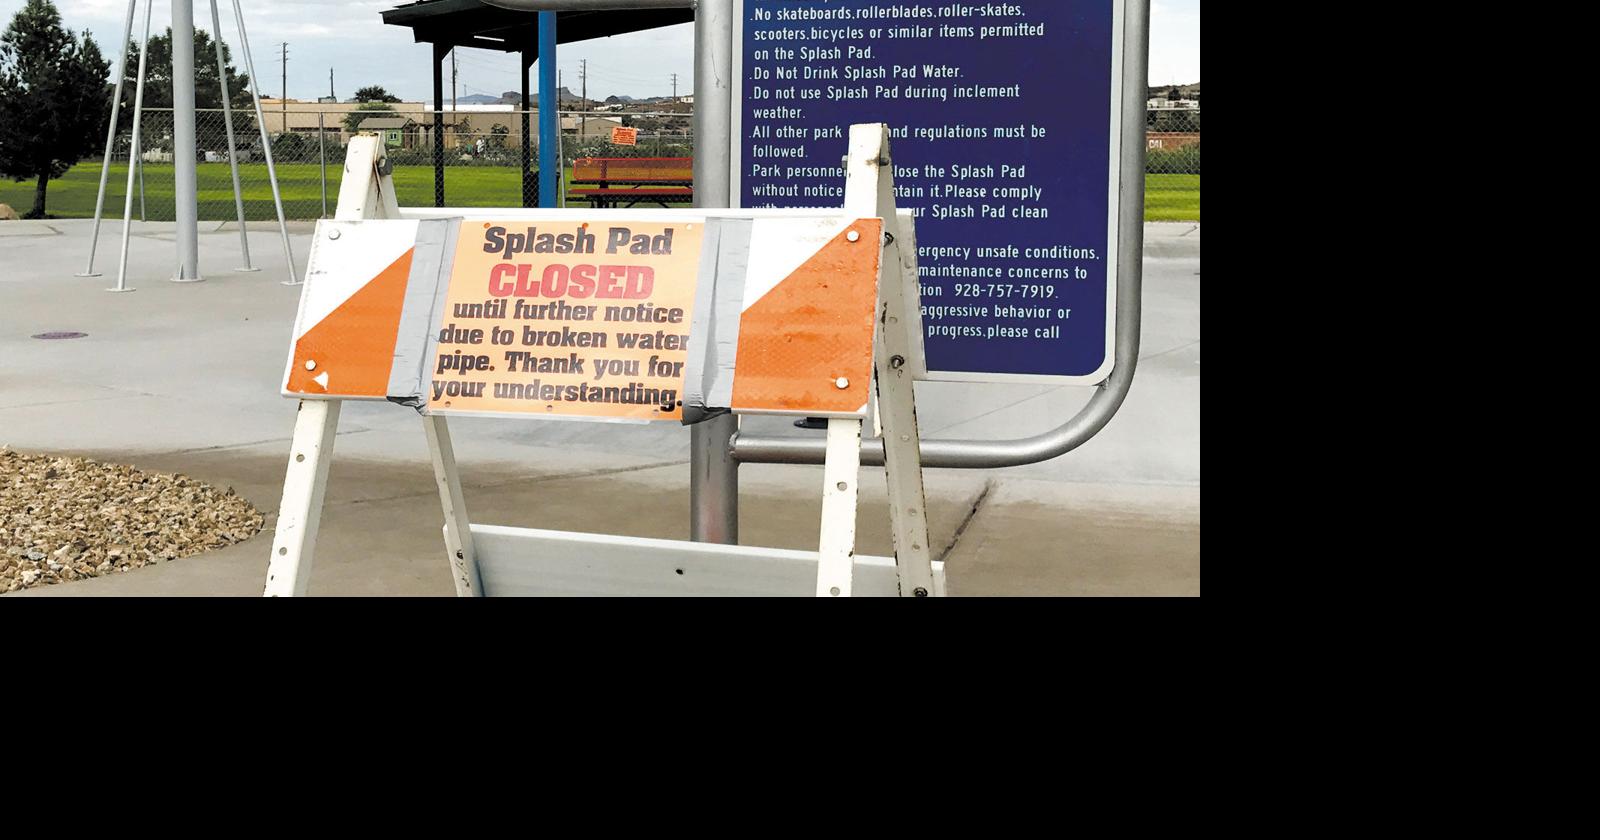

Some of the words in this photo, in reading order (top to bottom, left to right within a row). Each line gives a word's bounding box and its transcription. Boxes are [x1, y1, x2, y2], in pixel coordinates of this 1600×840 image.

[869, 28, 883, 39] or
[887, 24, 934, 39] similar
[939, 24, 975, 38] items
[980, 22, 1044, 40] permitted
[754, 50, 769, 61] on
[774, 46, 795, 60] the
[799, 46, 841, 62] Splash
[848, 45, 876, 60] Pad.
[776, 66, 798, 80] Not
[803, 65, 839, 80] Drink
[844, 65, 886, 82] Splash
[893, 65, 917, 79] Pad
[922, 64, 964, 79] Water.
[775, 86, 795, 100] not
[800, 88, 821, 99] use
[826, 85, 868, 102] Splash
[875, 85, 899, 99] Pad
[904, 84, 947, 102] during
[953, 84, 1020, 99] inclement
[753, 105, 806, 119] weather.
[775, 125, 809, 139] other
[814, 125, 842, 141] park
[914, 124, 988, 141] regulations
[993, 124, 1025, 138] must
[1031, 124, 1046, 138] be
[753, 144, 808, 158] followed.
[893, 164, 919, 178] lose
[924, 164, 945, 178] the
[951, 164, 994, 181] Splash
[1001, 164, 1025, 178] Pad
[752, 183, 799, 198] without
[804, 184, 843, 198] notice
[992, 184, 1042, 201] comply
[931, 203, 975, 220] Splash
[981, 204, 1006, 218] Pad
[1011, 204, 1048, 219] clean
[483, 226, 595, 260] Splash
[605, 227, 674, 255] Pad
[918, 246, 971, 261] ergency
[976, 244, 1019, 258] unsafe
[918, 263, 1002, 279] maintenance
[1008, 267, 1069, 279] concerns
[1074, 265, 1088, 280] to
[488, 263, 655, 300] CLOSED
[453, 298, 508, 319] until
[513, 299, 597, 321] further
[604, 302, 684, 324] notice
[921, 304, 988, 318] aggressive
[994, 304, 1052, 319] behavior
[1057, 308, 1071, 319] or
[439, 323, 484, 345] due
[491, 325, 515, 346] to
[521, 325, 608, 348] broken
[616, 330, 690, 351] water
[1034, 325, 1060, 339] call
[436, 349, 496, 376] pipe.
[504, 350, 585, 375] Thank
[593, 358, 641, 380] you
[647, 355, 684, 378] for
[432, 379, 487, 402] your
[493, 378, 683, 412] understanding.
